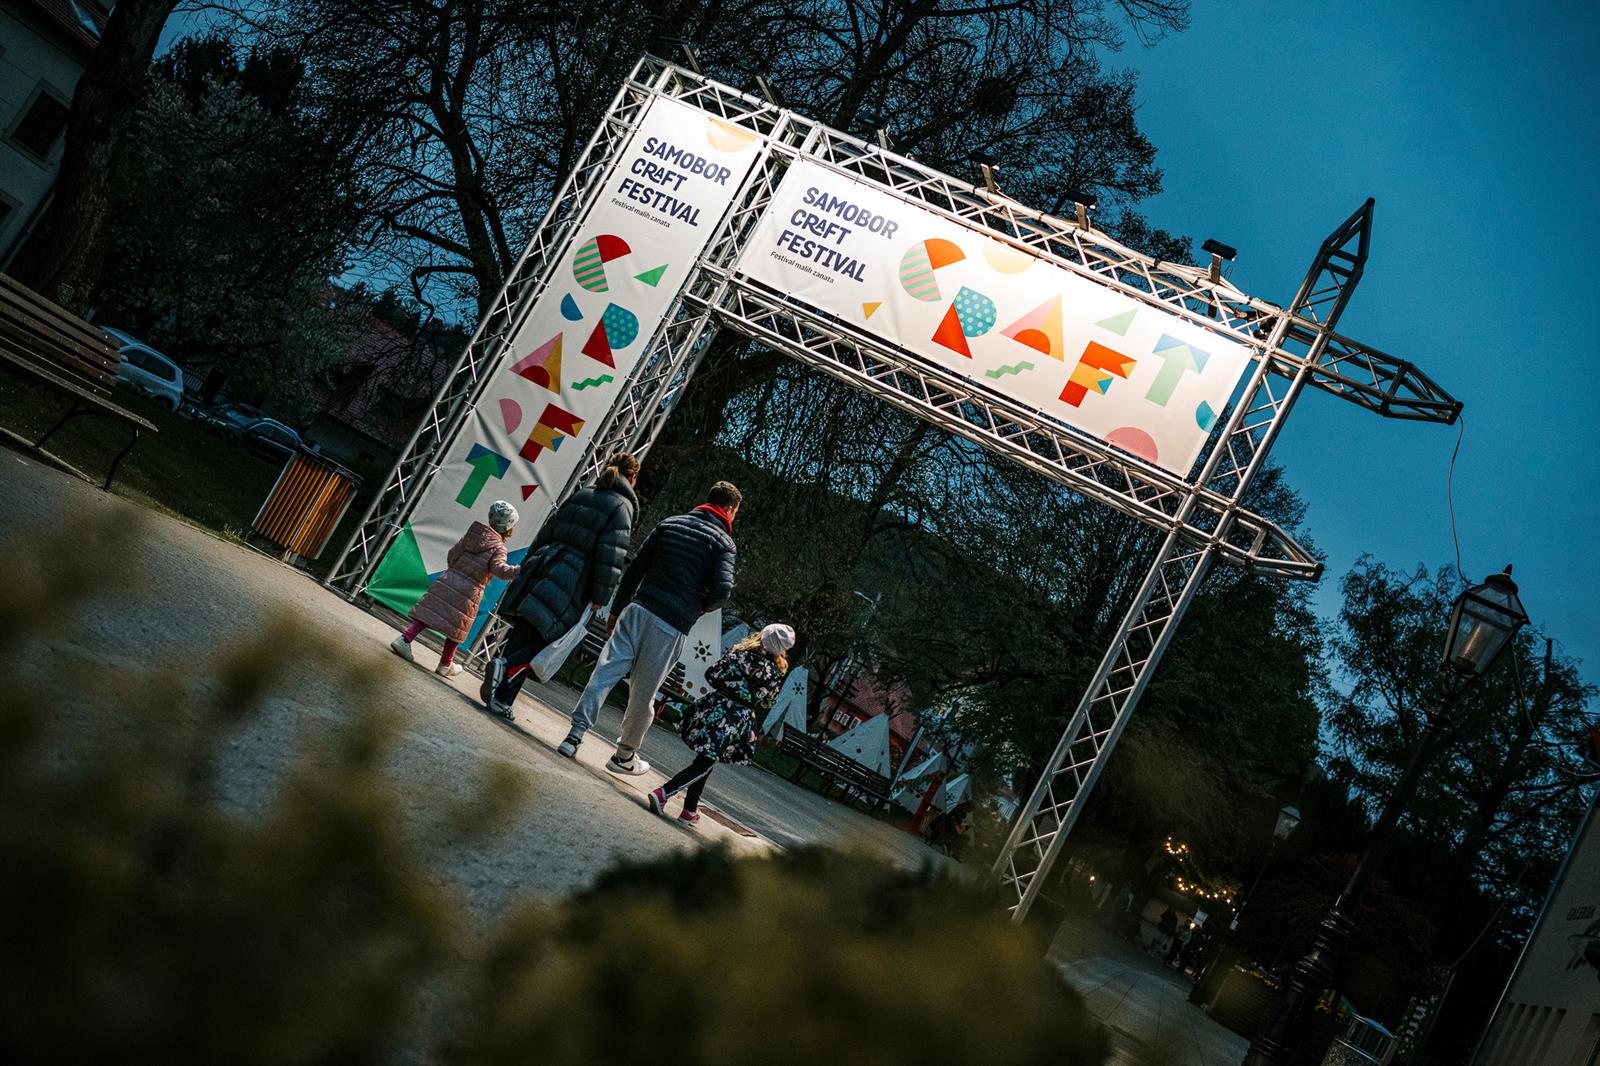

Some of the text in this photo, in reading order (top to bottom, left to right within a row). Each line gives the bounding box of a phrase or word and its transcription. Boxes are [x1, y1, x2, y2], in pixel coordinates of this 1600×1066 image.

[631, 158, 687, 192] CRAFT
[643, 137, 731, 186] SAMOBOR
[611, 198, 671, 228] Festival malih zanata
[617, 178, 700, 227] FESTIVAL
[802, 187, 898, 240] SAMOBOR
[790, 209, 852, 245] CRAFT
[770, 251, 834, 283] Festival malih zanata
[776, 229, 866, 283] FESTIVAL
